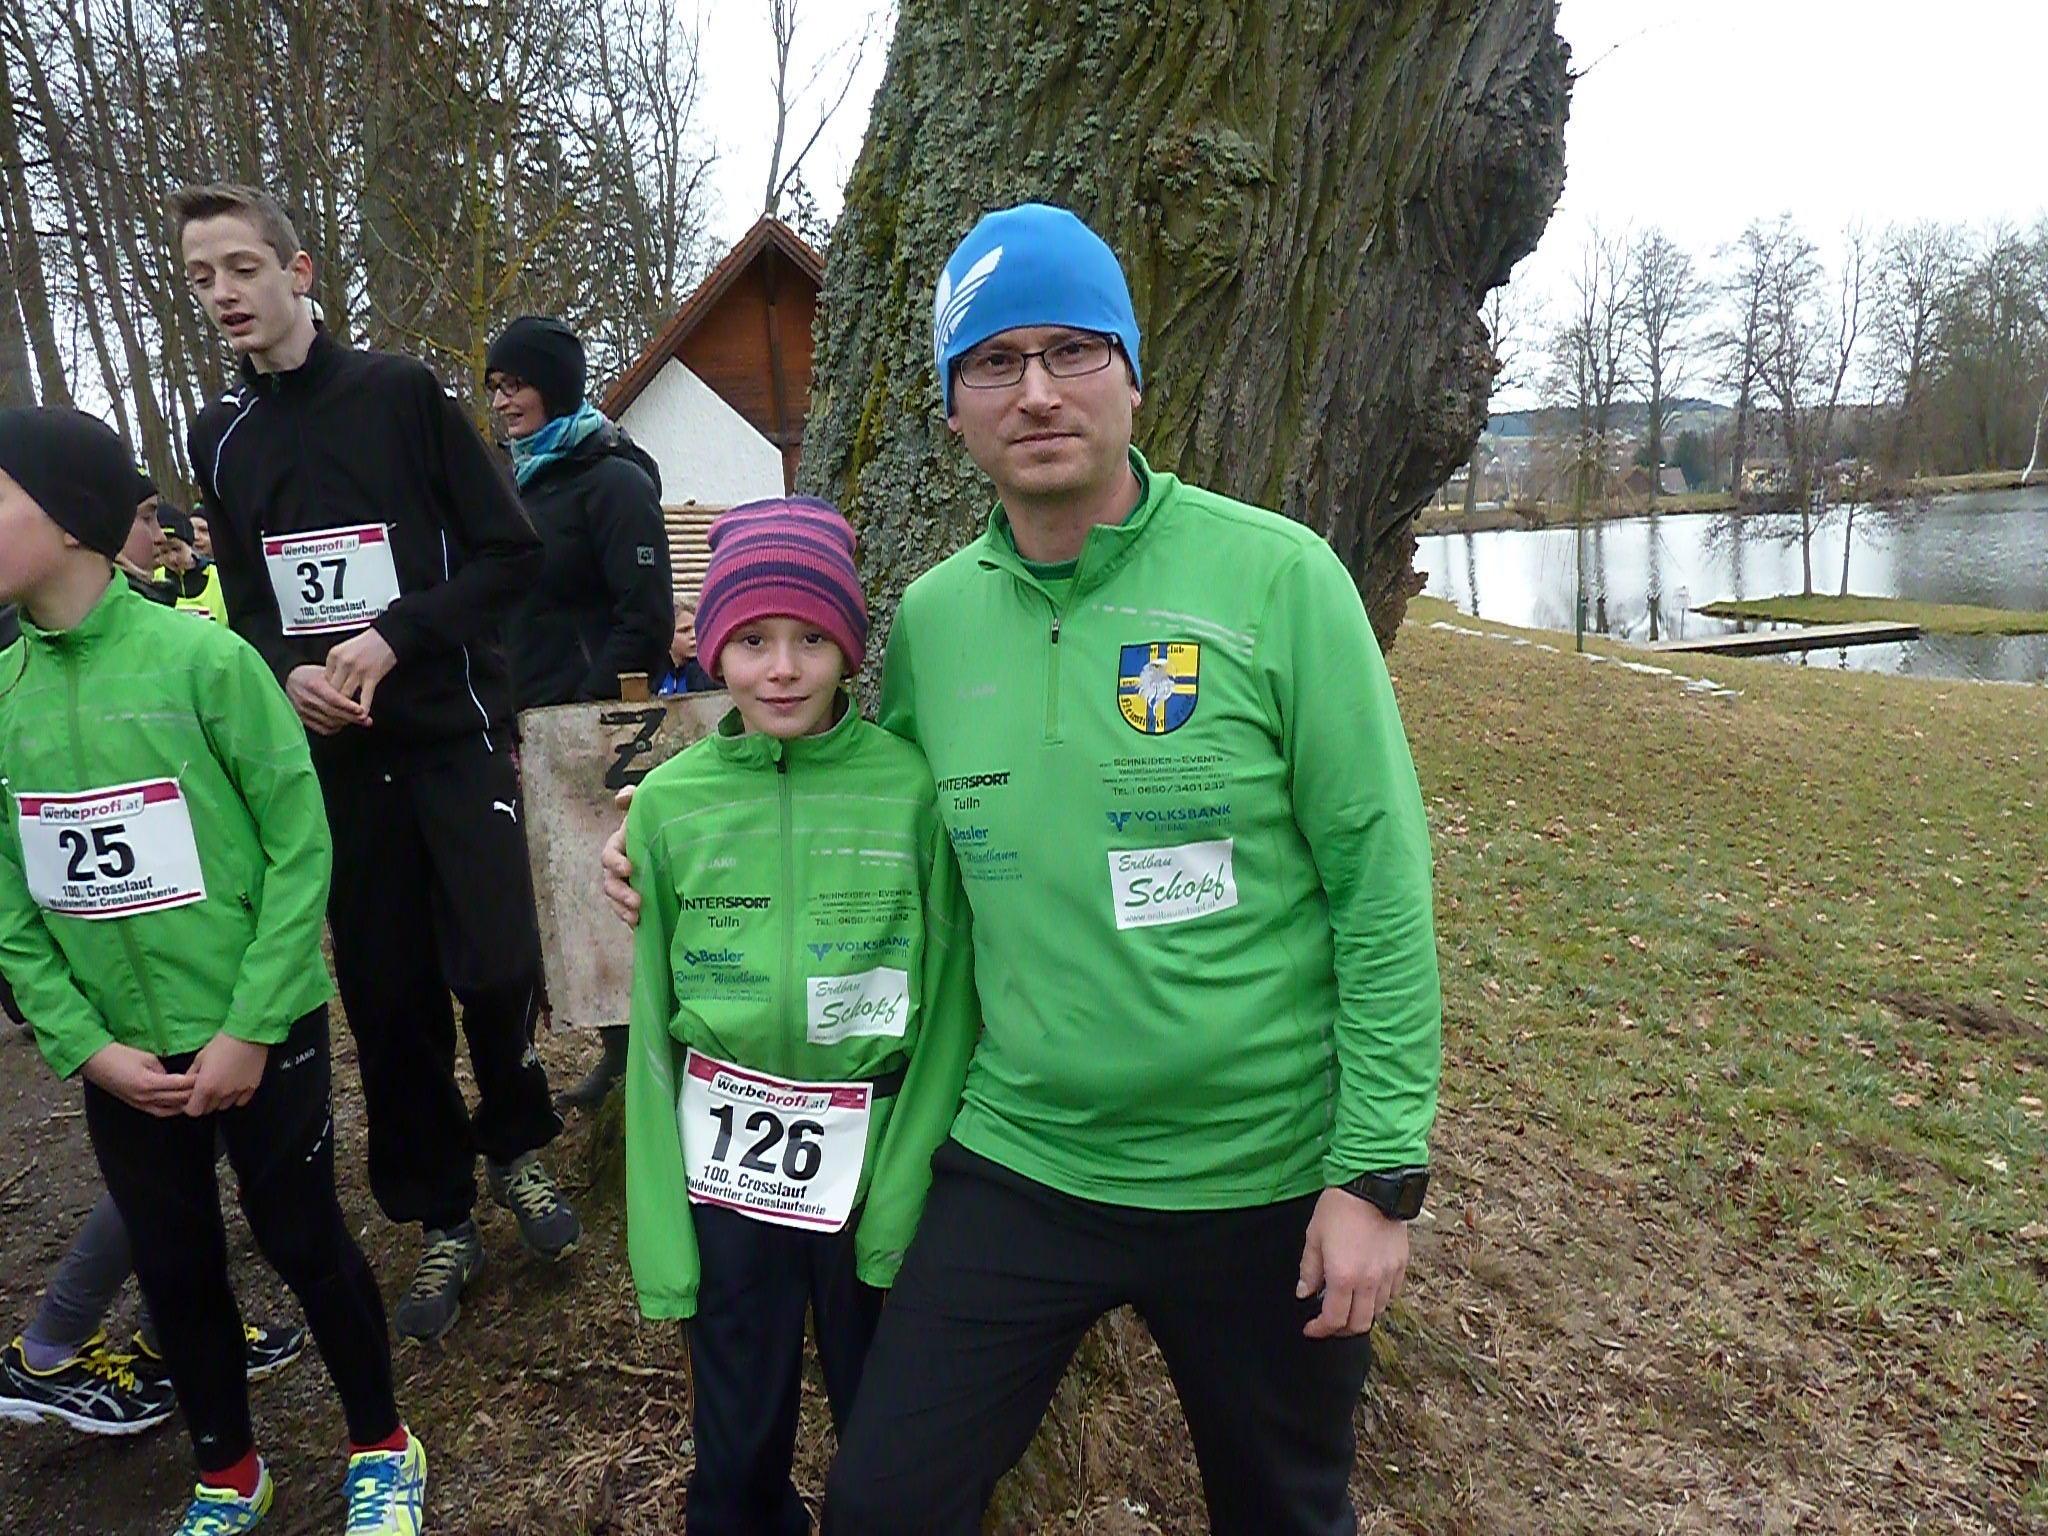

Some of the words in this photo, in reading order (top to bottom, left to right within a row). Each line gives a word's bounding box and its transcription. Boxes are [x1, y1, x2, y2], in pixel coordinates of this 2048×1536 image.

[296, 557, 348, 604] 37
[300, 606, 318, 616] 100.
[319, 599, 367, 615] Crosslauf
[942, 771, 1011, 792] INTERSPORT
[953, 796, 980, 810] Tulln
[1134, 803, 1232, 822] VOLKSBANK
[58, 823, 136, 882] 25
[1118, 854, 1172, 872] Erdbau
[62, 884, 85, 898] 100.
[87, 876, 154, 898] Crosslauf
[1124, 860, 1226, 908] Schopf
[99, 886, 179, 908] Crosslaufserie
[682, 896, 771, 911] INTERSPORT
[707, 915, 740, 928] Tulln
[836, 936, 911, 952] VOLKSBANK
[699, 947, 744, 963] Basler
[815, 981, 861, 998] Erdbau
[816, 994, 903, 1030] Schopf
[716, 1077, 826, 1109] werbeprofi.at
[709, 1103, 825, 1181] 126
[703, 1164, 732, 1186] 100.
[737, 1172, 808, 1200] Crosslauf
[745, 1192, 827, 1216] Crosslaufserie
